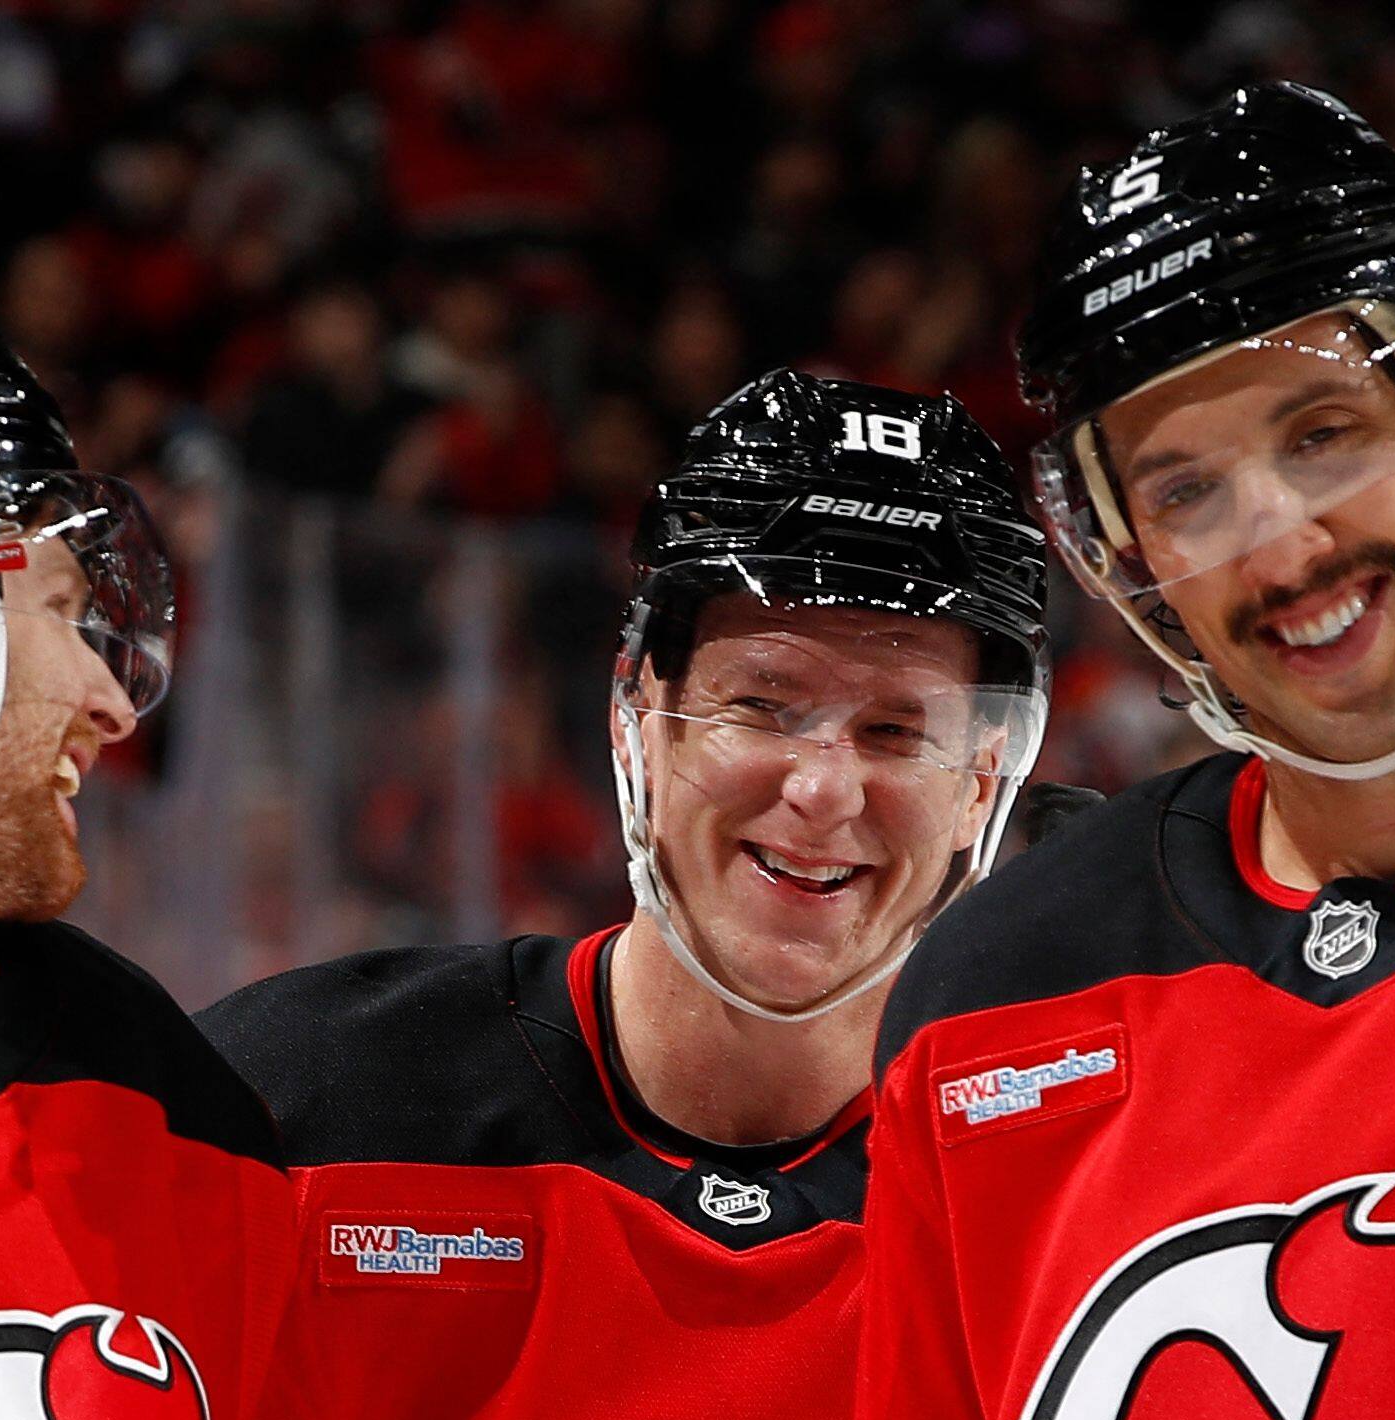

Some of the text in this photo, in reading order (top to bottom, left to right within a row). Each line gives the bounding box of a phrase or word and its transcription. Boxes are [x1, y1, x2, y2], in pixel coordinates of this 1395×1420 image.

[1109, 155, 1164, 218] 5
[1082, 237, 1214, 317] BAUER
[838, 411, 921, 460] 18
[800, 494, 943, 531] BAUER
[1319, 922, 1369, 964] NHL
[940, 1048, 1117, 1114] RWJBarnabas
[966, 1090, 1042, 1124] HEALTH
[715, 1193, 767, 1214] NHL
[330, 1225, 524, 1261] RWJBarnabas
[357, 1253, 441, 1274] HEALTH
